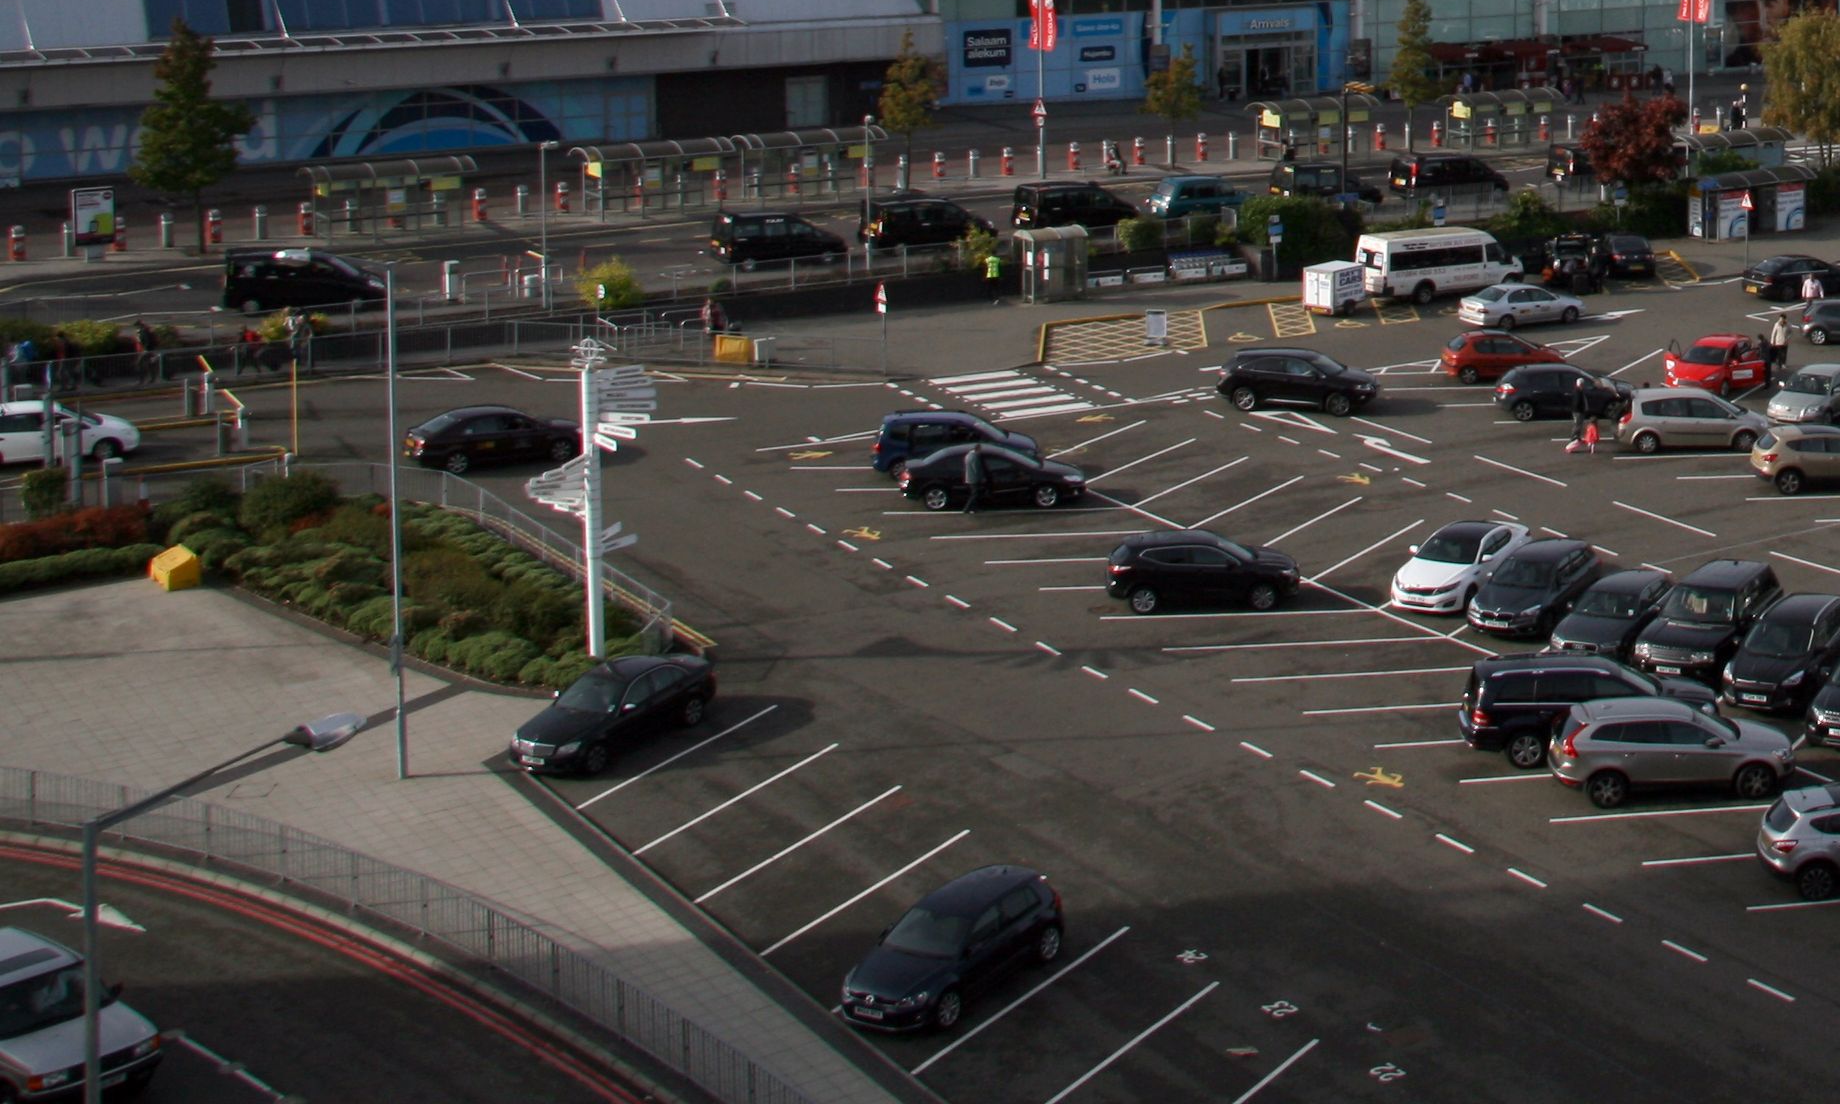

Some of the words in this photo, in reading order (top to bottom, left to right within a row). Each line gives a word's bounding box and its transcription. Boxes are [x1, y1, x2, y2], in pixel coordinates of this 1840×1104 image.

[1249, 17, 1290, 31] Arrivals
[966, 35, 1008, 48] Salaam
[967, 47, 1007, 60] alekum
[1092, 72, 1117, 85] Hola
[1338, 275, 1363, 287] CARS
[1368, 1061, 1408, 1083] 22
